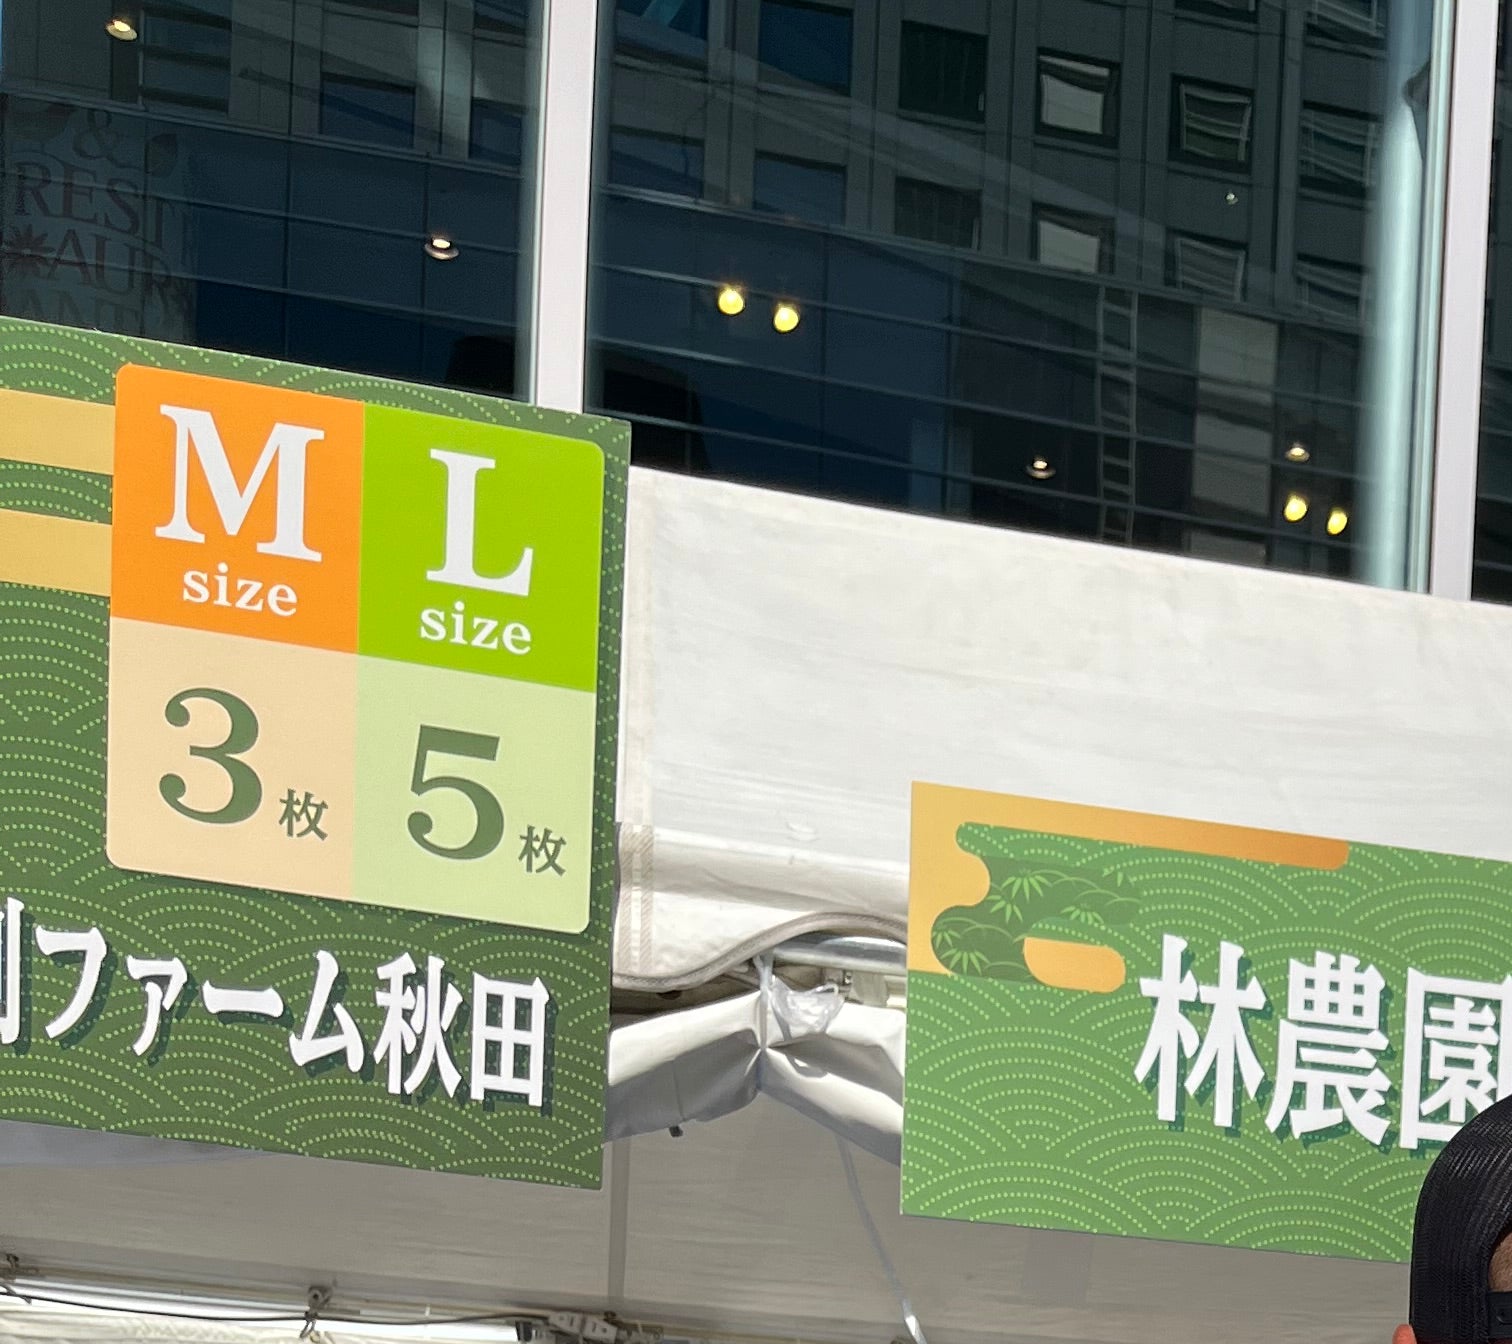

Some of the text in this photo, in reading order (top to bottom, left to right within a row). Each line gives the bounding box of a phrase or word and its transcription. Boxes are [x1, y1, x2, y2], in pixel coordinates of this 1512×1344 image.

[155, 403, 325, 562] M
[426, 447, 535, 596] L
[182, 562, 299, 616] size
[419, 601, 533, 656] size
